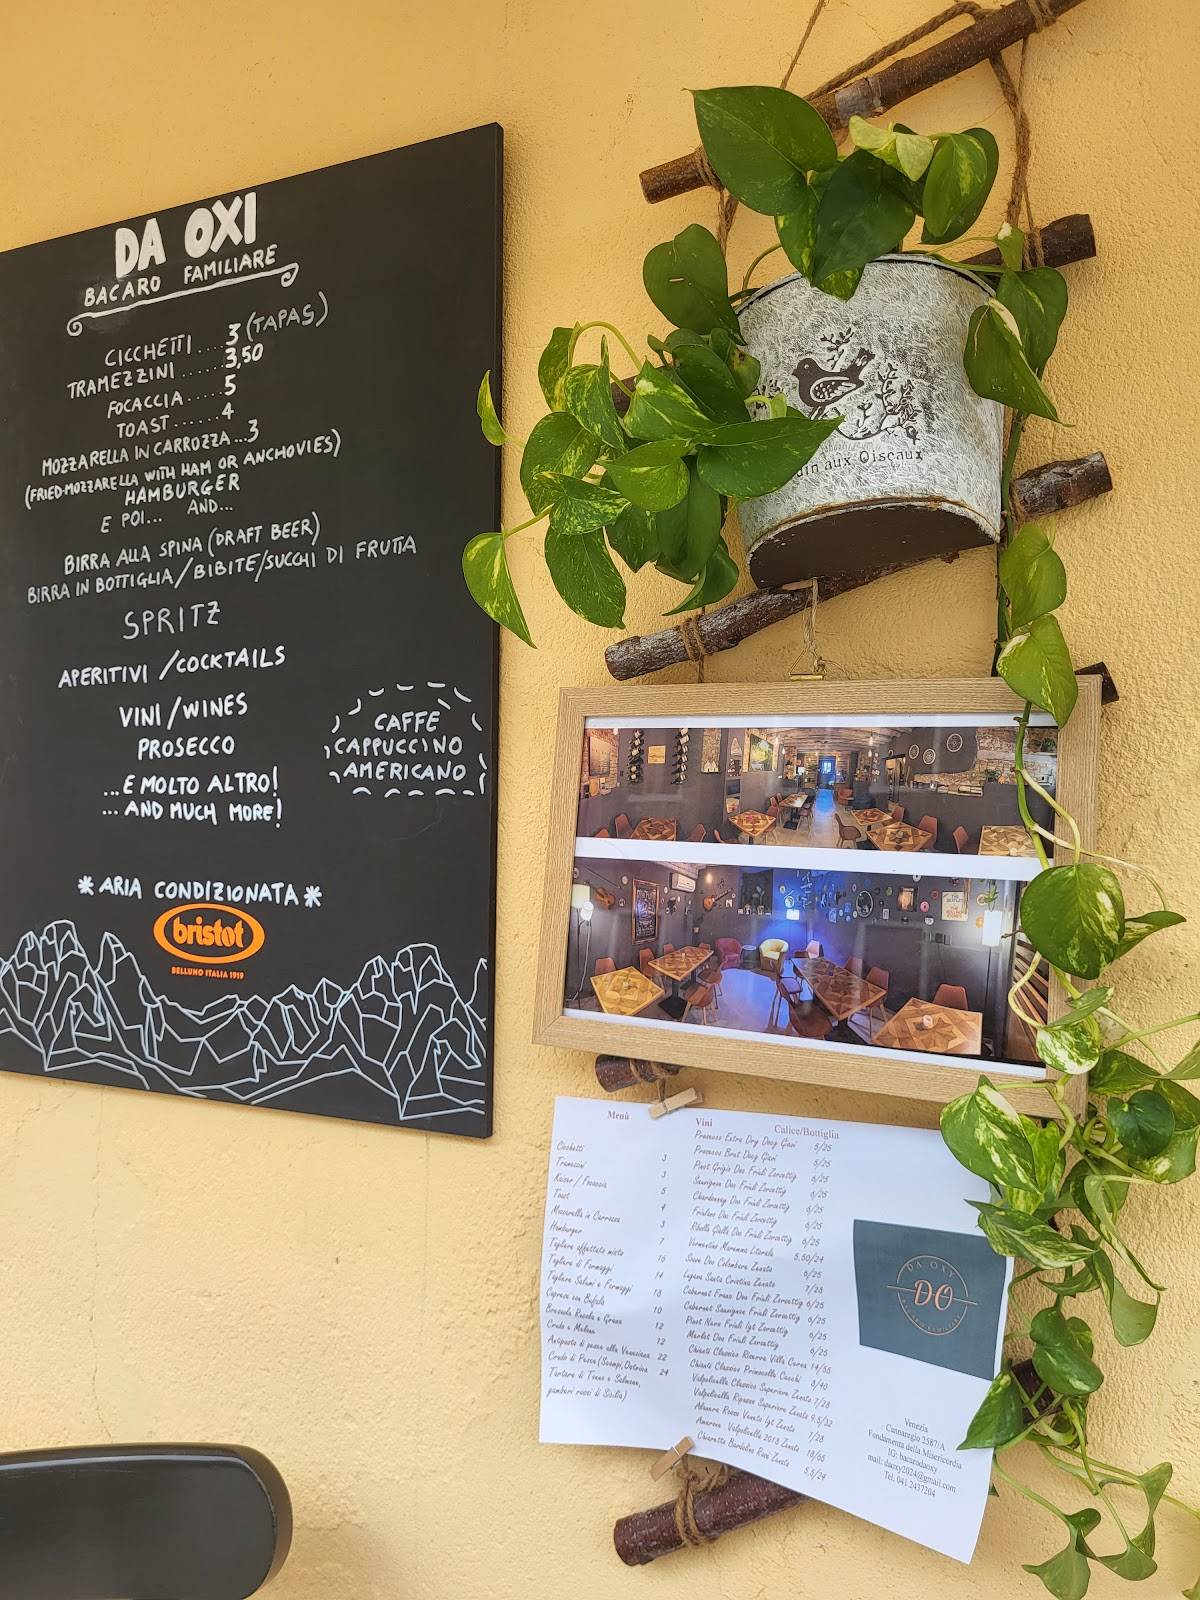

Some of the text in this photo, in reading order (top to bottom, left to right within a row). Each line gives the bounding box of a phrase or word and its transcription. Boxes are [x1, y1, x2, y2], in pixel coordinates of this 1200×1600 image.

[116, 192, 256, 278] DA OXI
[84, 244, 277, 306] BACARO FAMILIARE
[105, 335, 191, 366] CICCHETTI
[247, 292, 327, 341] (TAPAS)
[67, 343, 263, 398] TRAMEZZINI 3,50
[108, 374, 236, 418] FOCACCIA 5
[117, 402, 234, 438] TOAST 4
[43, 448, 128, 476] MOZZARELLA
[135, 445, 149, 460] IN
[154, 431, 230, 455] CARROZZA
[145, 466, 175, 481] WITH
[181, 460, 211, 476] HAM
[218, 455, 238, 469] OR
[243, 429, 340, 465] ANCHOVIES)
[824, 456, 851, 471] aux
[859, 450, 923, 464] Oiseaux
[125, 470, 240, 505] HAMBURGER
[101, 499, 232, 533] E POI... AND...
[65, 512, 320, 575] BIRRA ALLA SPINA (DRAFT BEER)
[28, 584, 70, 603] BIRRA
[76, 579, 89, 596] IN
[326, 546, 342, 563] DI
[356, 536, 416, 559] FRUTTA
[123, 601, 220, 639] SPRITZ
[58, 664, 147, 688] APERITIVI
[138, 736, 234, 760] PROSECCO
[335, 736, 462, 756] CAPPUCCINO
[140, 776, 199, 795] MOLTO
[207, 766, 277, 797] ALTRO!
[343, 761, 466, 781] AMERICANO
[170, 802, 217, 825] MUCH
[229, 798, 281, 828] MORE!
[99, 876, 299, 906] ARIA CONDIZIONATA
[173, 916, 244, 948] bristot
[171, 966, 244, 980] BELLUNO ITALIA 1919
[695, 1117, 839, 1139] Vini Calice/Bottiglia
[653, 1306, 662, 1314] 10
[915, 1279, 953, 1311] DO
[655, 1322, 664, 1330] 12
[658, 1353, 667, 1361] 22
[886, 1424, 945, 1452] Cannaregio 2587/A
[904, 1417, 928, 1433] Venezia
[868, 1429, 962, 1470] Fondamenta della Misericordia
[888, 1448, 937, 1474] IG: bacarodaoxy
[868, 1454, 956, 1493] mail: daoxy2024@gmail.com
[884, 1471, 936, 1497] Tel. 041 2437204
